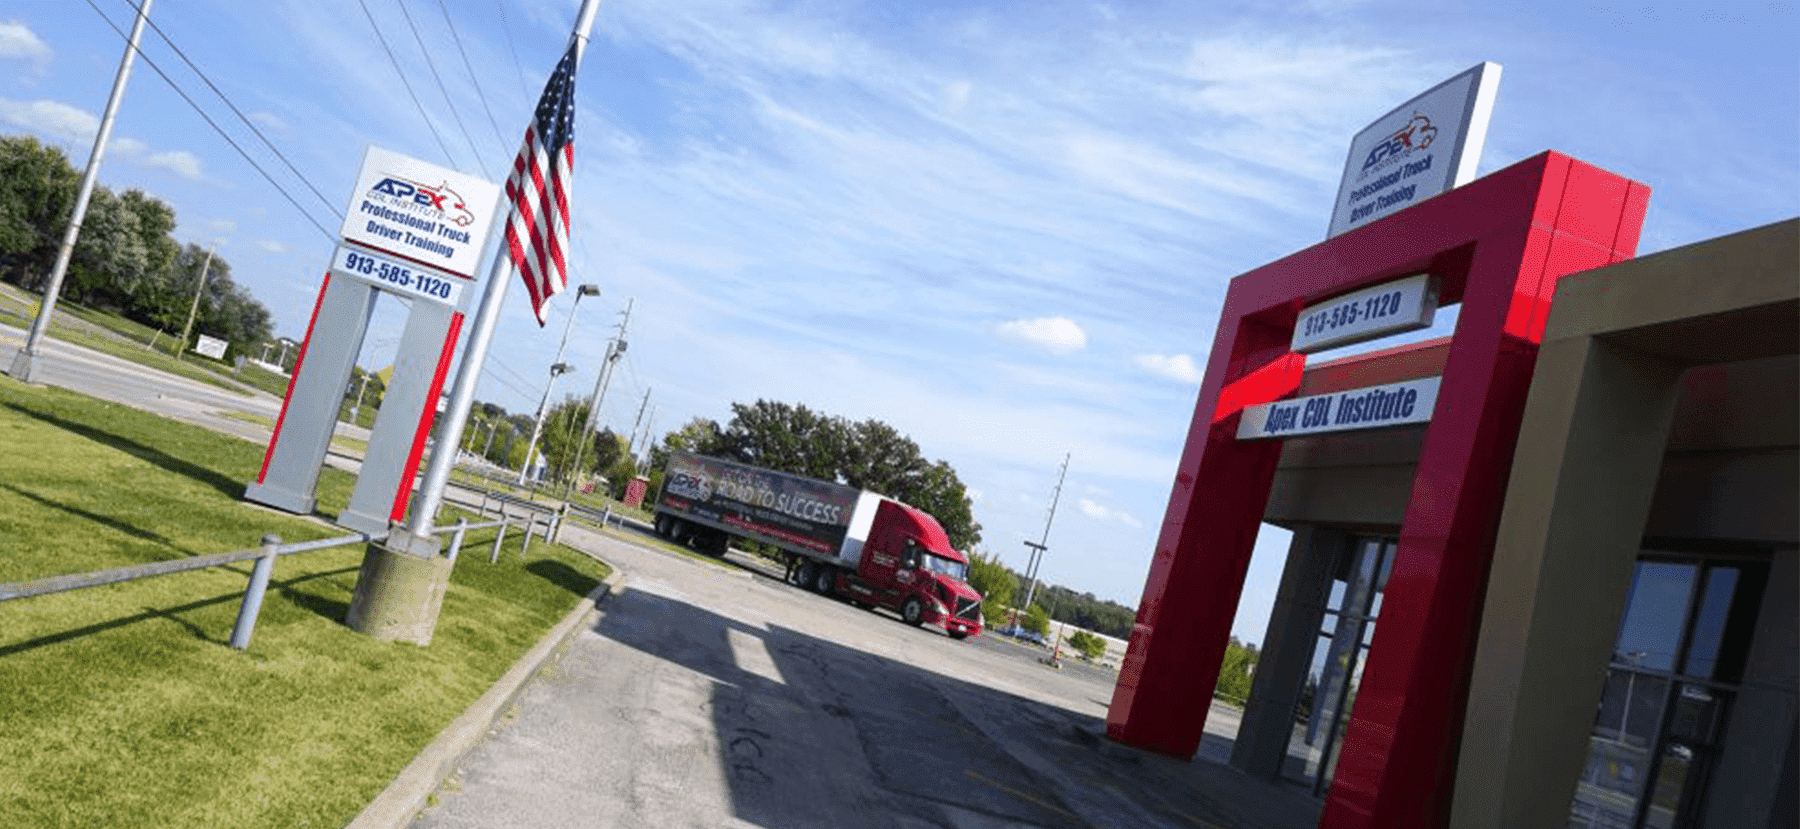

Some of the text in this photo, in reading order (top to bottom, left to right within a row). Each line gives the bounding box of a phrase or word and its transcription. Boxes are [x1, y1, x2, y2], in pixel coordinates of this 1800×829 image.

[1362, 124, 1416, 171] APEX
[372, 177, 448, 211] APEX
[1349, 153, 1434, 205] Professional Truck
[360, 200, 471, 245] Professional Truck
[389, 197, 446, 221] INSTITUTE
[1350, 184, 1417, 223] Driver Training
[366, 220, 455, 258] Driver Training
[345, 252, 452, 299] 913-585-1120
[1304, 291, 1402, 337] 913-585-1120
[1263, 387, 1418, 434] Apex CDL Institute
[716, 479, 755, 504] ROAD
[757, 489, 775, 508] TO
[776, 493, 841, 525] SUCCESS
